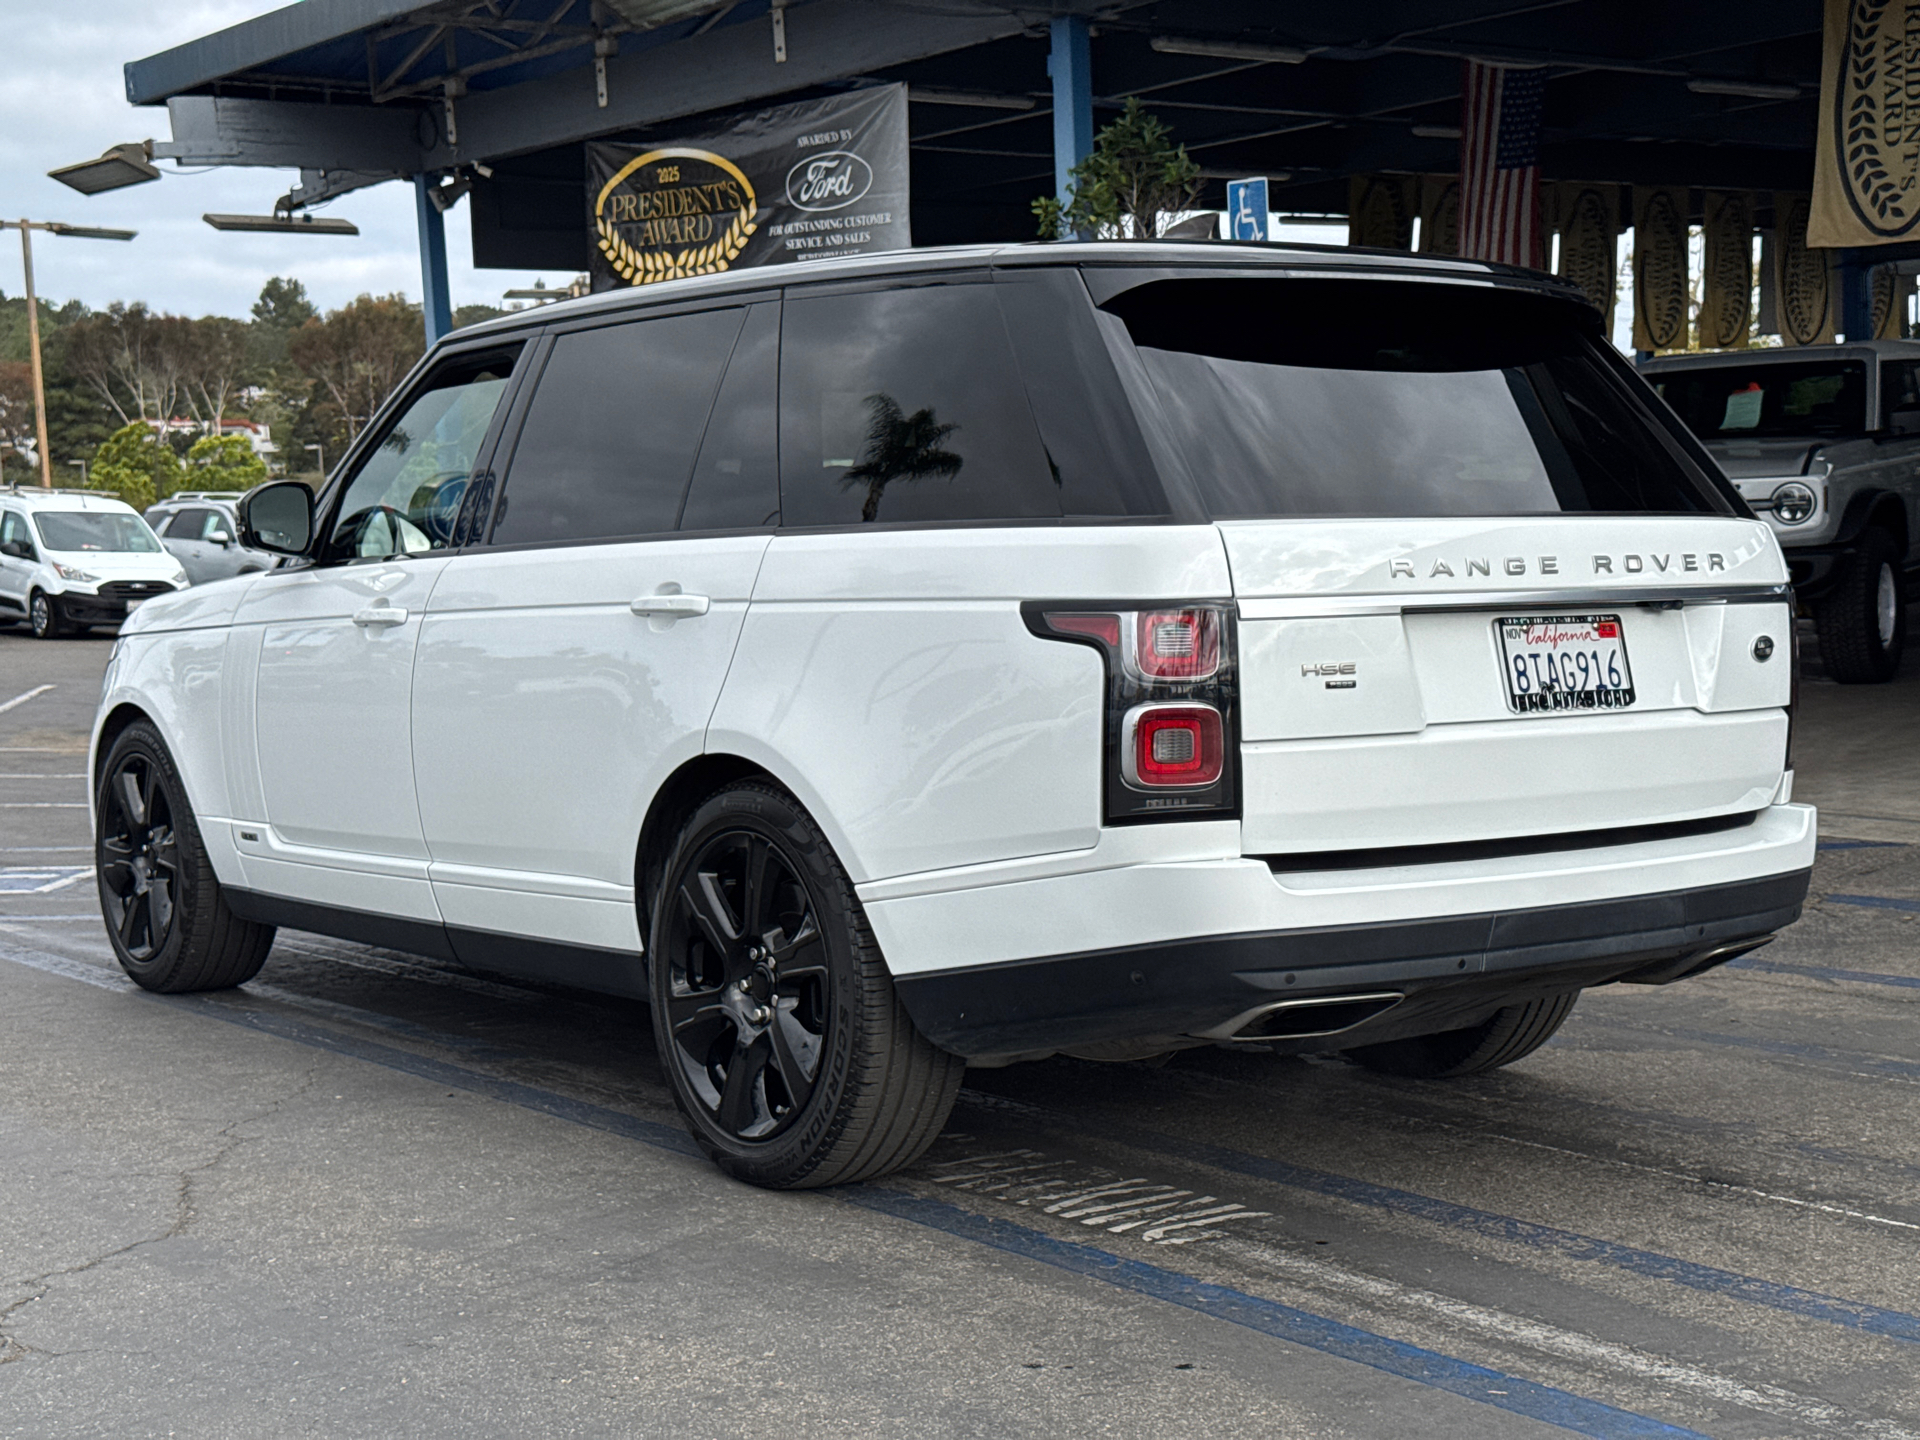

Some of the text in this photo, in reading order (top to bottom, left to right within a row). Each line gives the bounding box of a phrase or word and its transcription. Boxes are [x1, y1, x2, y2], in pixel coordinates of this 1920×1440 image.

[1883, 35, 1902, 147] AWARD
[1901, 0, 1920, 192] RESIDENT'S
[797, 129, 852, 148] AWARDED BY
[656, 165, 680, 184] 2025
[800, 160, 854, 202] Ford
[611, 180, 742, 222] PRESIDENT'S
[639, 214, 713, 246] AWARD
[769, 212, 892, 237] FOR OUTSTANDING CUSTOMER
[785, 232, 871, 250] SERVICE AND SALES
[1389, 553, 1725, 578] RANGE ROVER
[1506, 628, 1521, 640] NOV
[1526, 625, 1600, 650] California
[1301, 662, 1356, 677] HSE
[1513, 649, 1622, 693] 8TAG916
[800, 1004, 849, 1153] SCORPION
